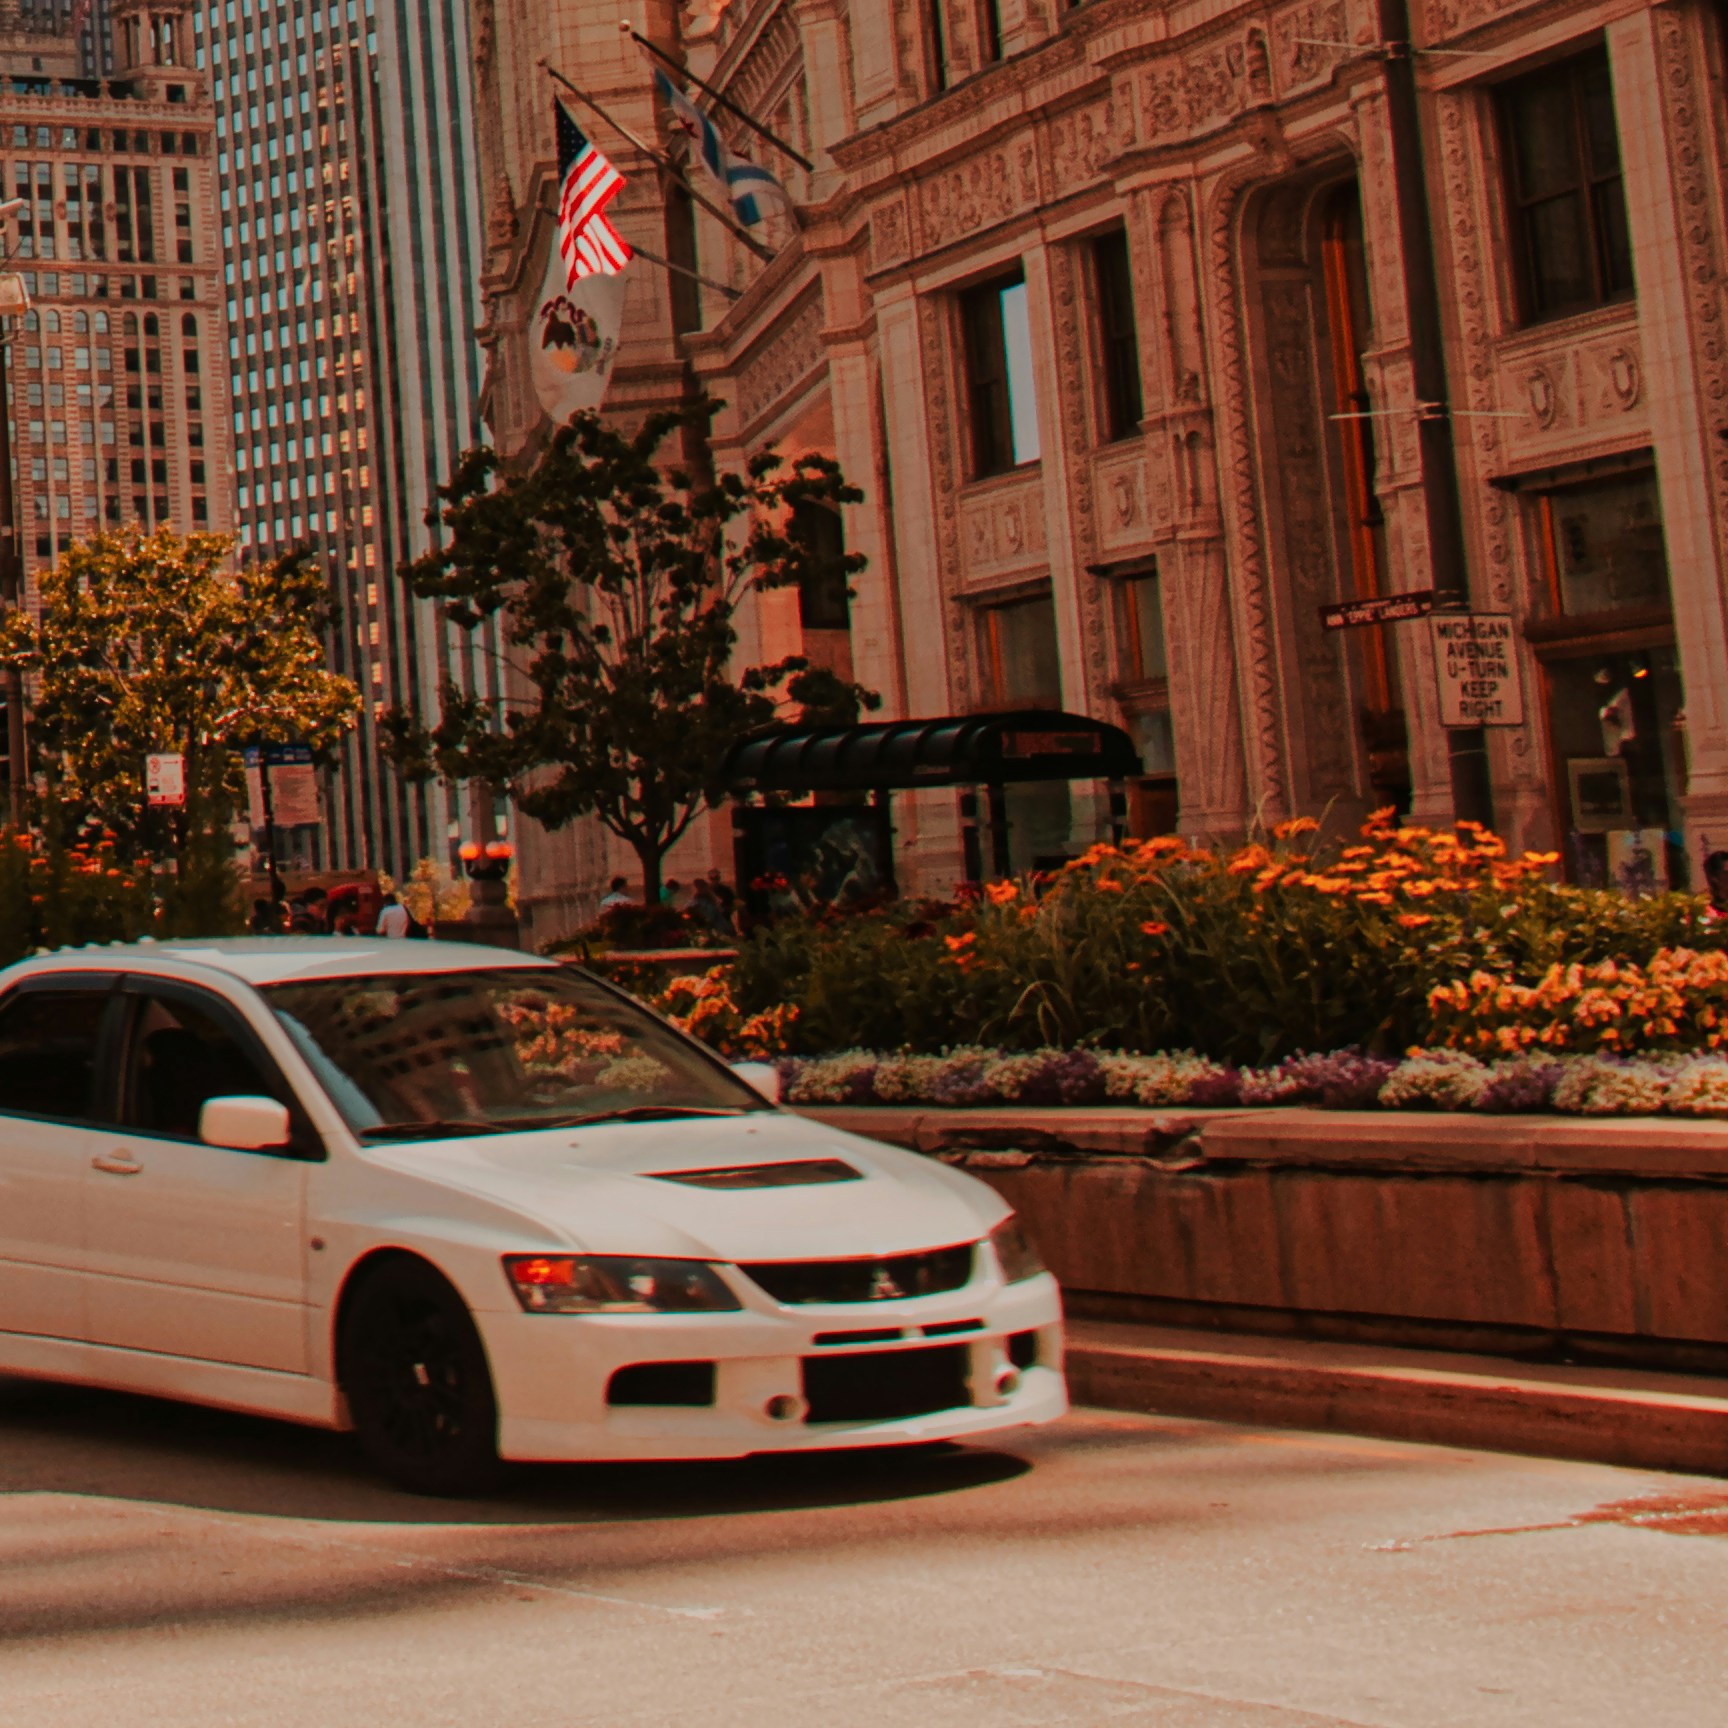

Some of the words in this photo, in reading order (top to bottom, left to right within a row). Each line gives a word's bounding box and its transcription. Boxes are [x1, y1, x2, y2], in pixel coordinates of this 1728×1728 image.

[1437, 622, 1509, 640] MICHIGAN
[1447, 642, 1505, 659] AVENUE
[1448, 661, 1509, 678] U-TURN
[1461, 681, 1499, 698] KEEP
[1459, 700, 1504, 718] RIGHT
